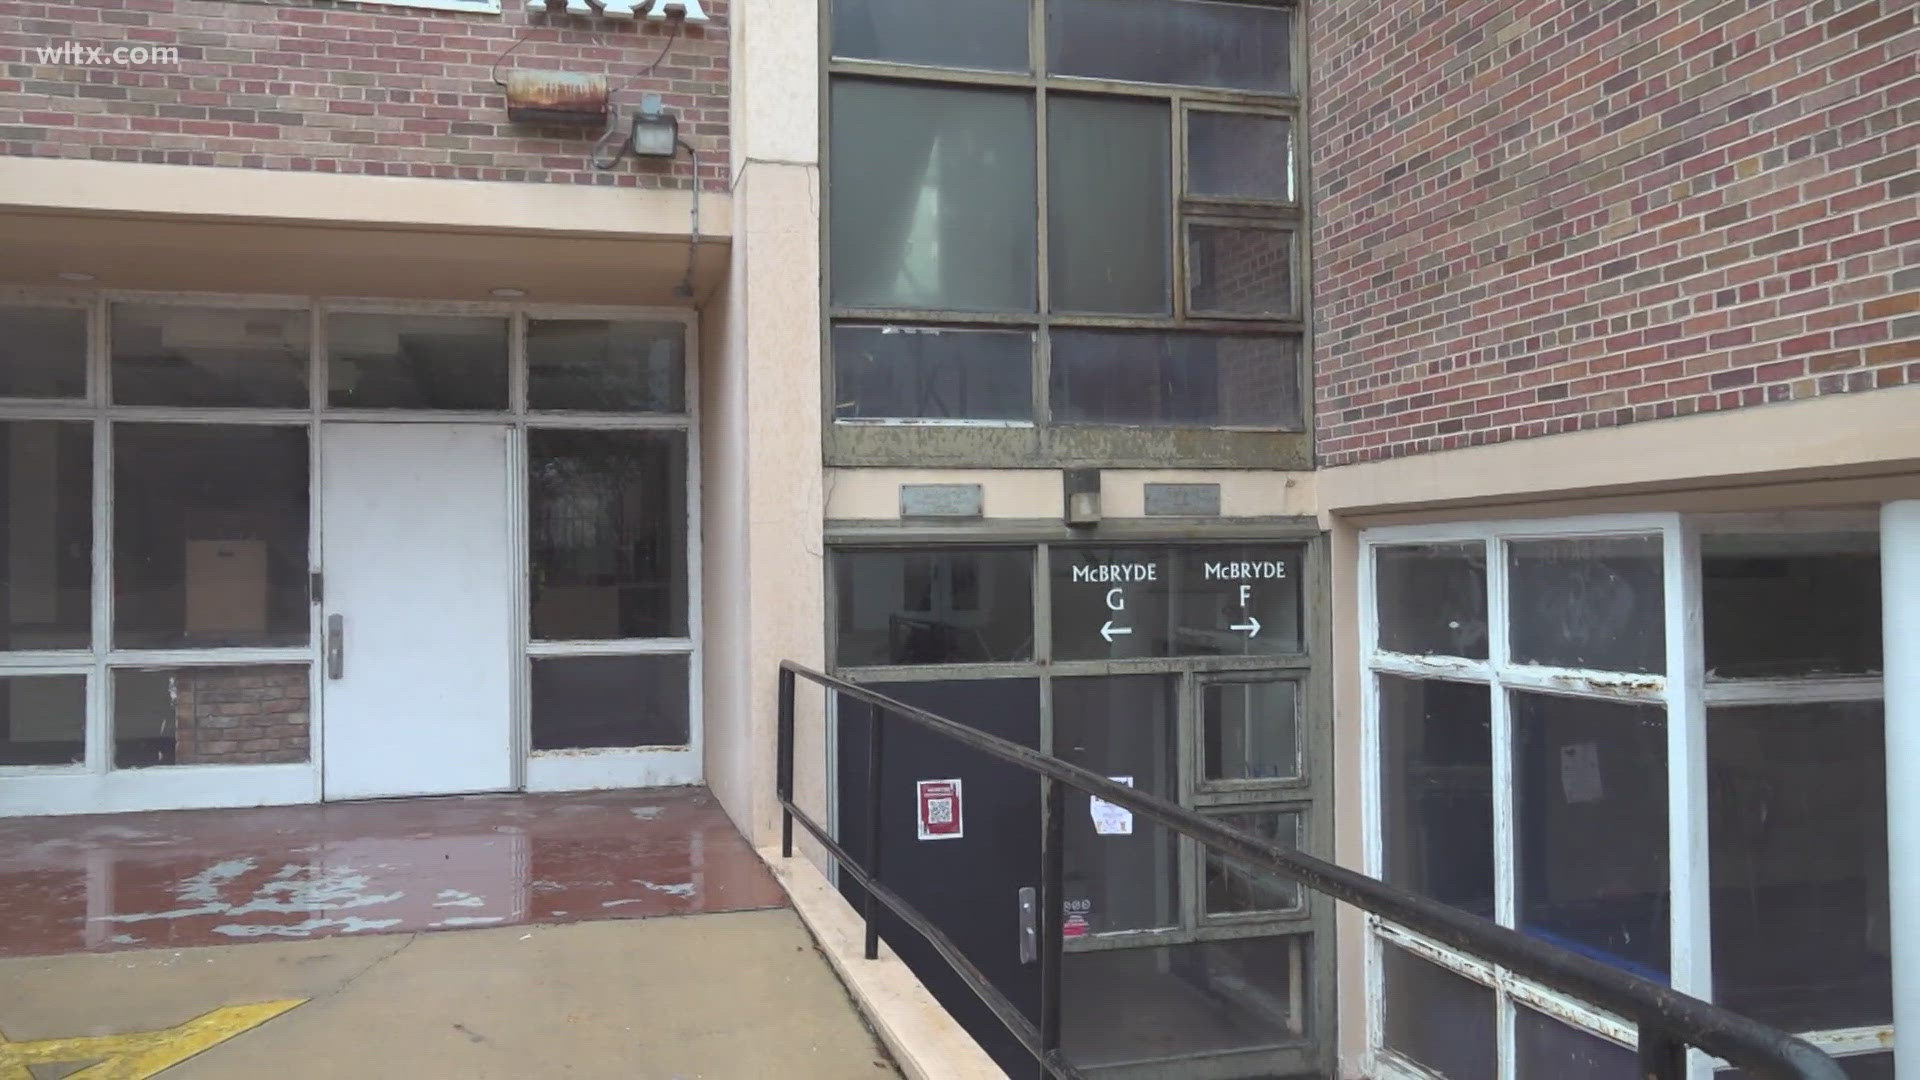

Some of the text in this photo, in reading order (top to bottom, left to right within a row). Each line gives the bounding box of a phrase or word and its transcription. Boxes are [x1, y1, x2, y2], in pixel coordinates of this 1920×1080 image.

[1072, 563, 1157, 583] McBRYDE
[1204, 561, 1286, 580] McBRYDE
[1106, 588, 1125, 611] G
[1239, 585, 1251, 607] F
